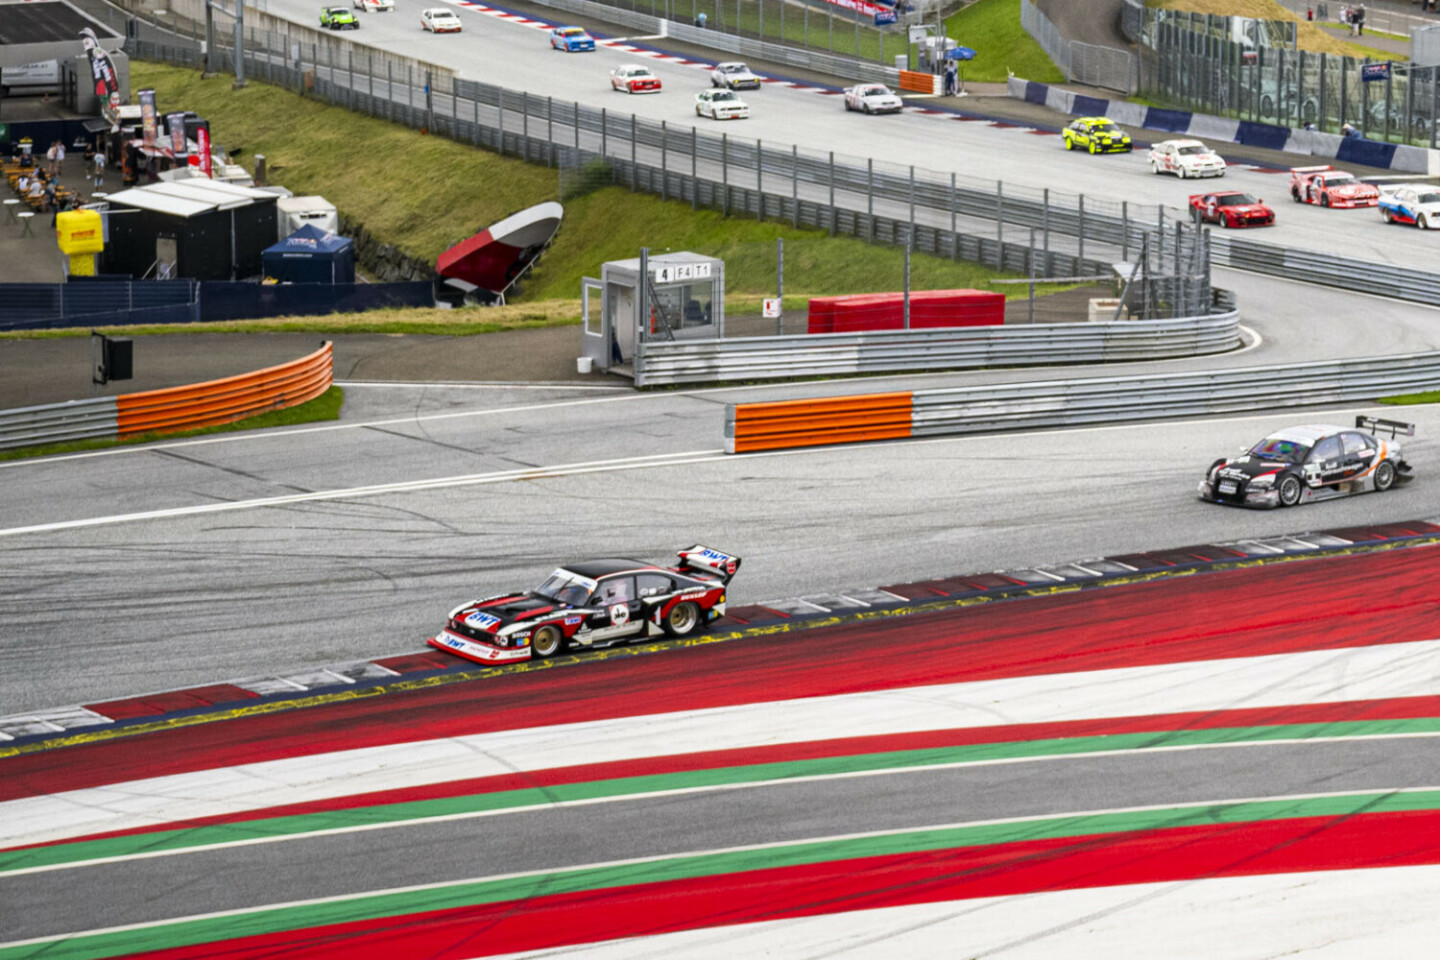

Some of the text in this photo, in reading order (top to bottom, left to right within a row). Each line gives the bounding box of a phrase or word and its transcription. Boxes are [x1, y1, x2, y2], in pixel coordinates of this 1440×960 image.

[662, 269, 668, 280] 4
[702, 548, 728, 561] BWT
[469, 611, 499, 627] BWT
